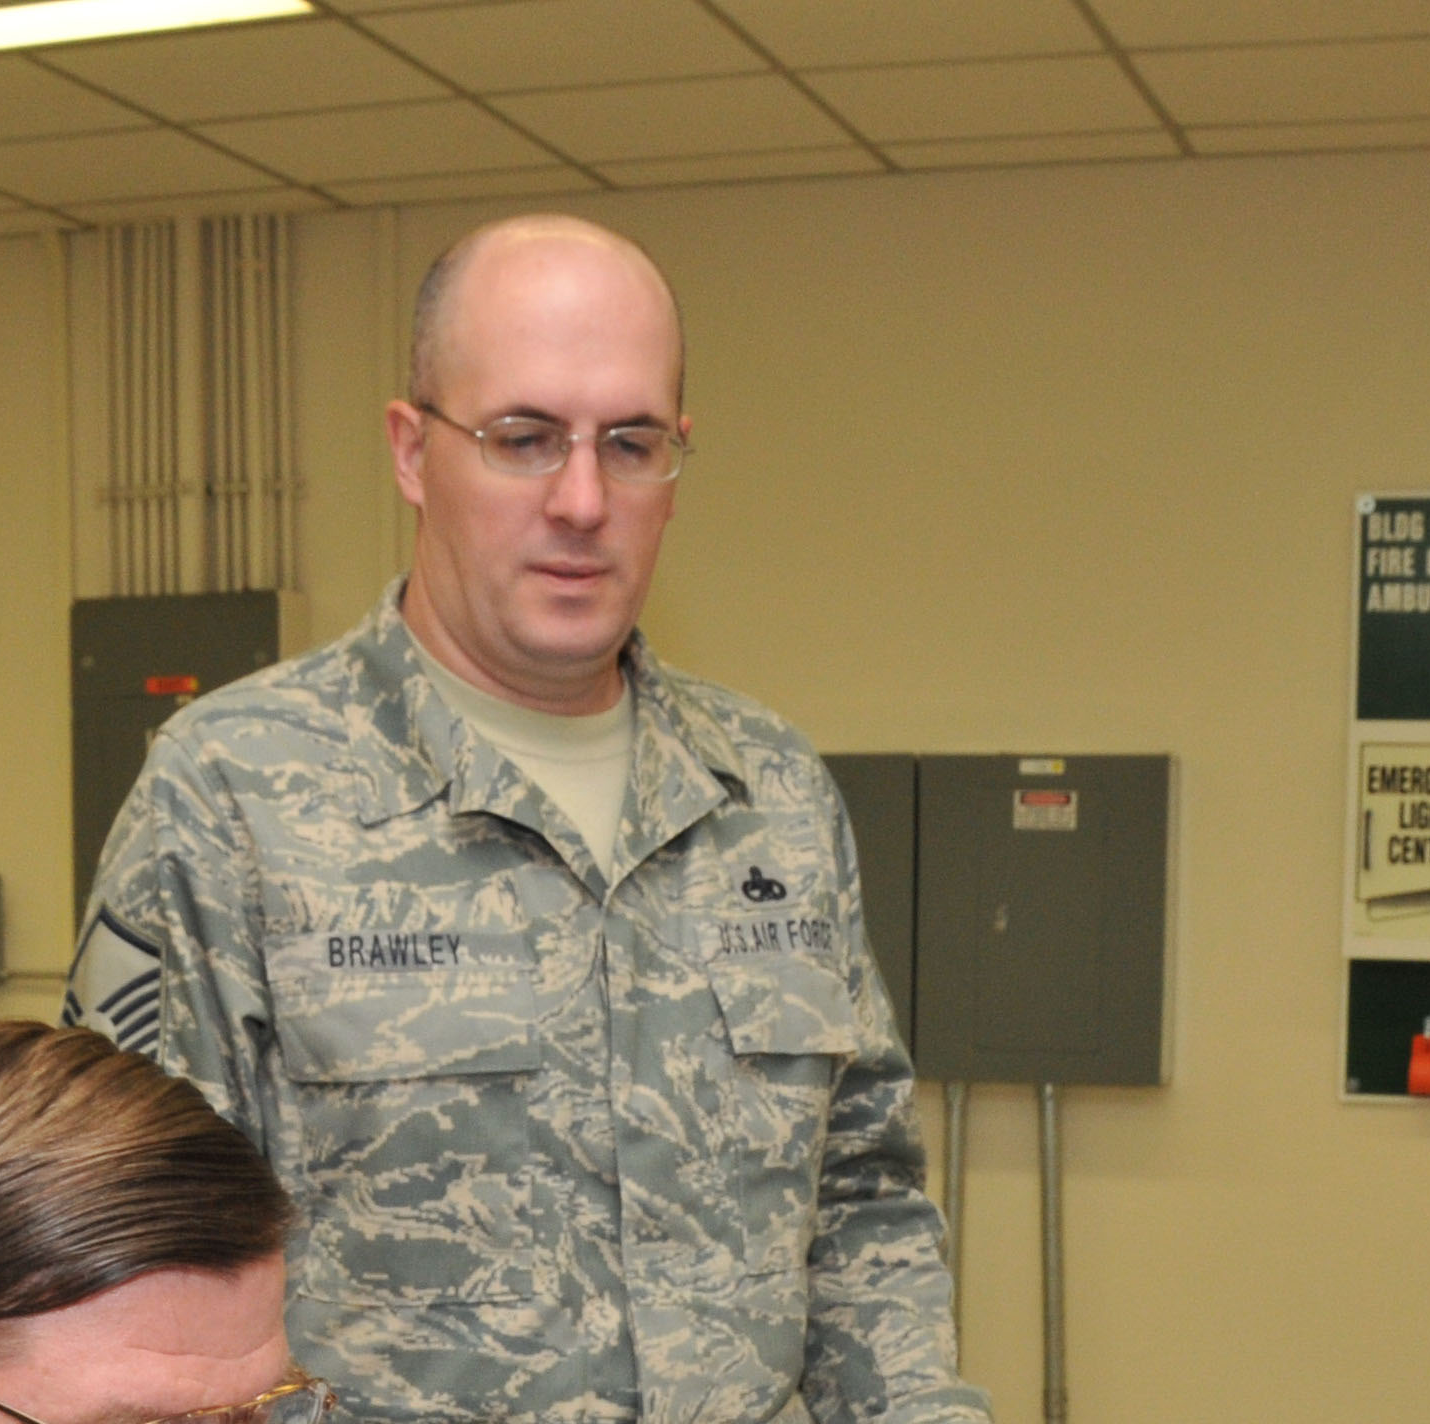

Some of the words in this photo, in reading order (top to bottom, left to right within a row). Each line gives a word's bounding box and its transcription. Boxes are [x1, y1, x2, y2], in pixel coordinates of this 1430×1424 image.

[1367, 511, 1424, 541] BLDG
[1367, 546, 1416, 577] FIRE
[328, 933, 460, 968] BRAWLEY
